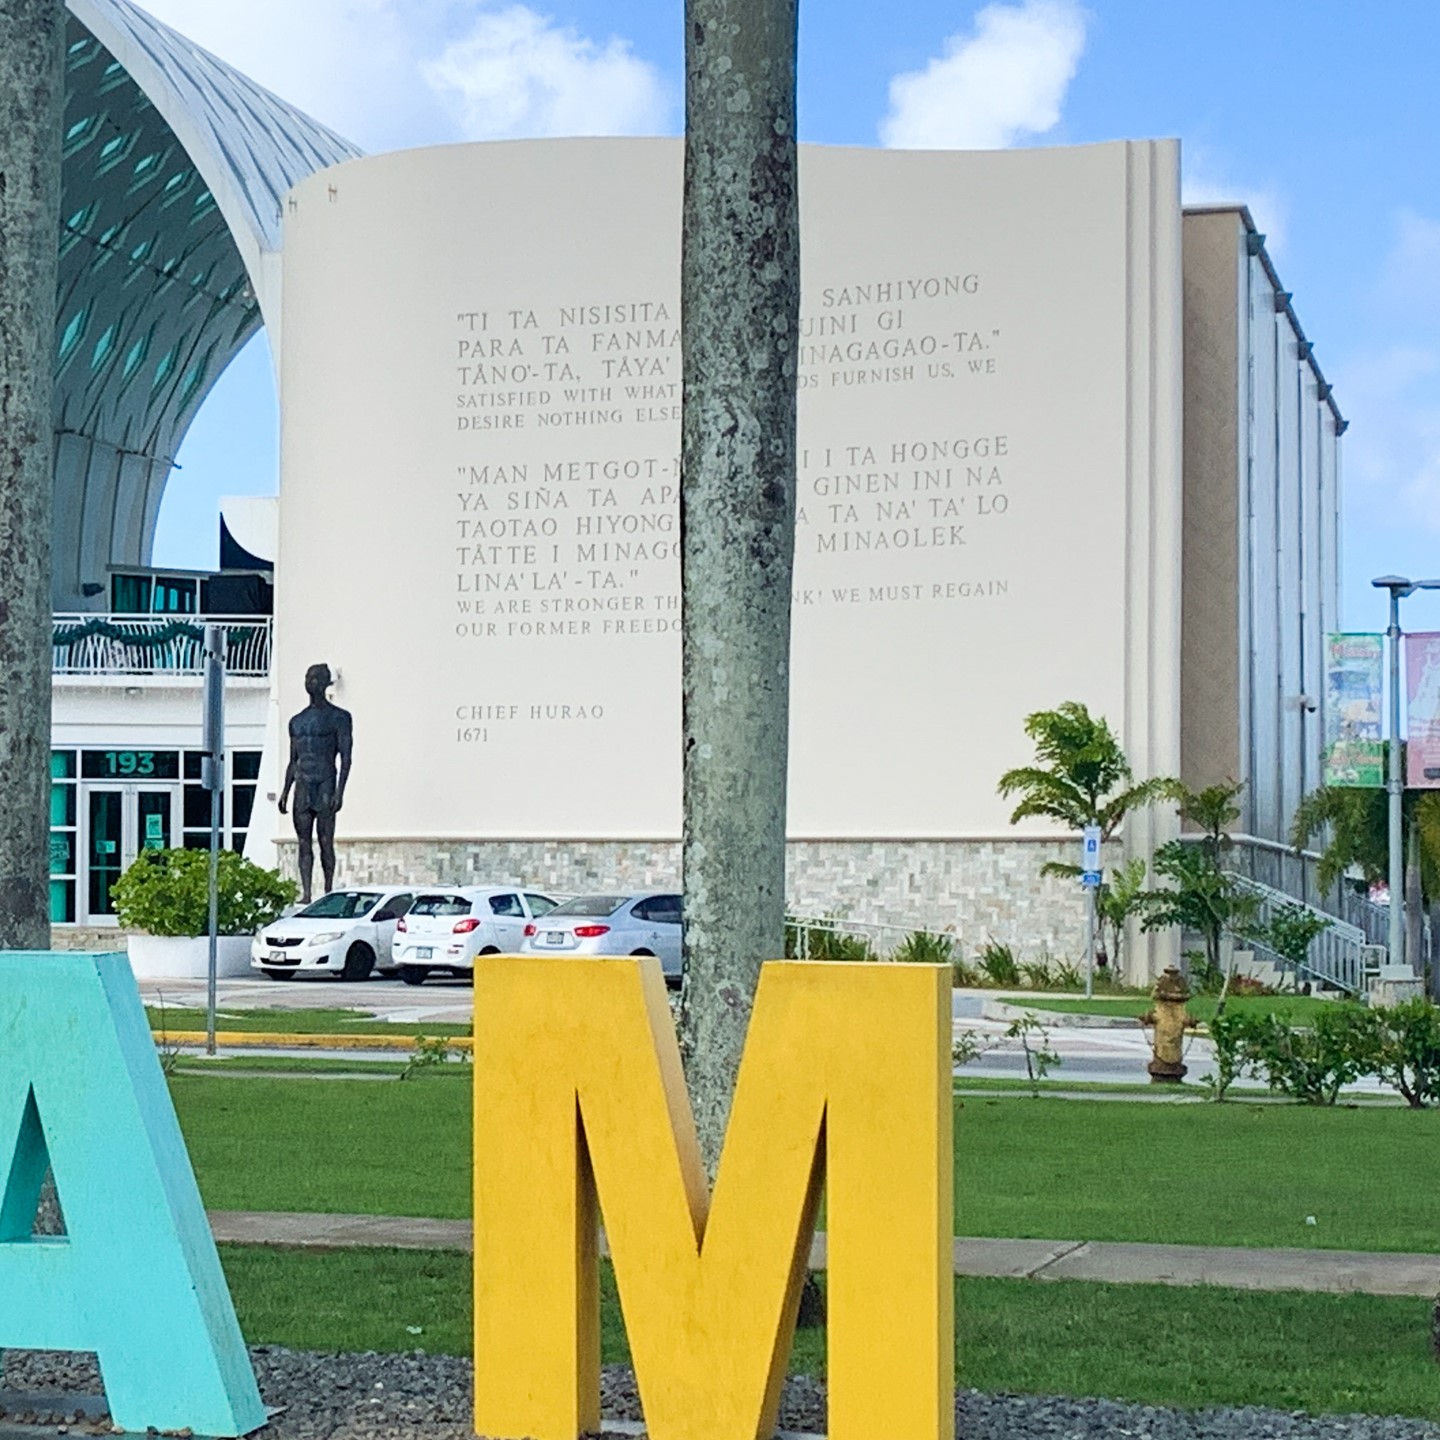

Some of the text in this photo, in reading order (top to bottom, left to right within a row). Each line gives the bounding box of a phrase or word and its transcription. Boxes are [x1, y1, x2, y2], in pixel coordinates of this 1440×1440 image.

[457, 274, 979, 331] "TI TA NISISITA SANHIYONG
[457, 310, 904, 358] PARA TA FANMA UINI GI
[601, 356, 670, 378] TÅYA'
[800, 328, 1001, 366] INAGAGAO-TA."
[456, 391, 551, 408] SATISFIED
[563, 387, 612, 402] WITH
[624, 384, 676, 399] WHAT
[831, 366, 914, 386] FURNISH
[967, 359, 996, 373] WE
[457, 415, 525, 430] DESIRE
[537, 410, 623, 426] NOTHING
[457, 465, 528, 485] "MAN
[824, 448, 832, 468] I
[845, 447, 877, 466] TA
[891, 436, 1008, 463] HONGGE
[457, 493, 489, 511] YA
[507, 487, 569, 510] SIÑA
[587, 488, 618, 507] TA
[813, 472, 899, 495] GINEN
[913, 469, 952, 490] INI
[965, 466, 1003, 486] NA
[456, 518, 558, 538] TAOTAO
[576, 514, 673, 535] HIYONG
[828, 505, 859, 523] TA
[455, 544, 537, 565] TÅTTE
[551, 544, 560, 564] I
[817, 526, 967, 553] MINAOLEK
[456, 600, 485, 614] WE
[493, 600, 531, 613] ARE
[540, 597, 645, 612] STRONGER
[653, 595, 678, 610] TH
[832, 589, 861, 602] WE
[869, 585, 923, 601] MUST
[932, 581, 1008, 598] REGAIN
[455, 617, 681, 637] OUR FORMER FREEDO
[456, 705, 604, 719] CHIEF HURAO
[456, 728, 488, 741] 1671
[105, 752, 155, 774] 193
